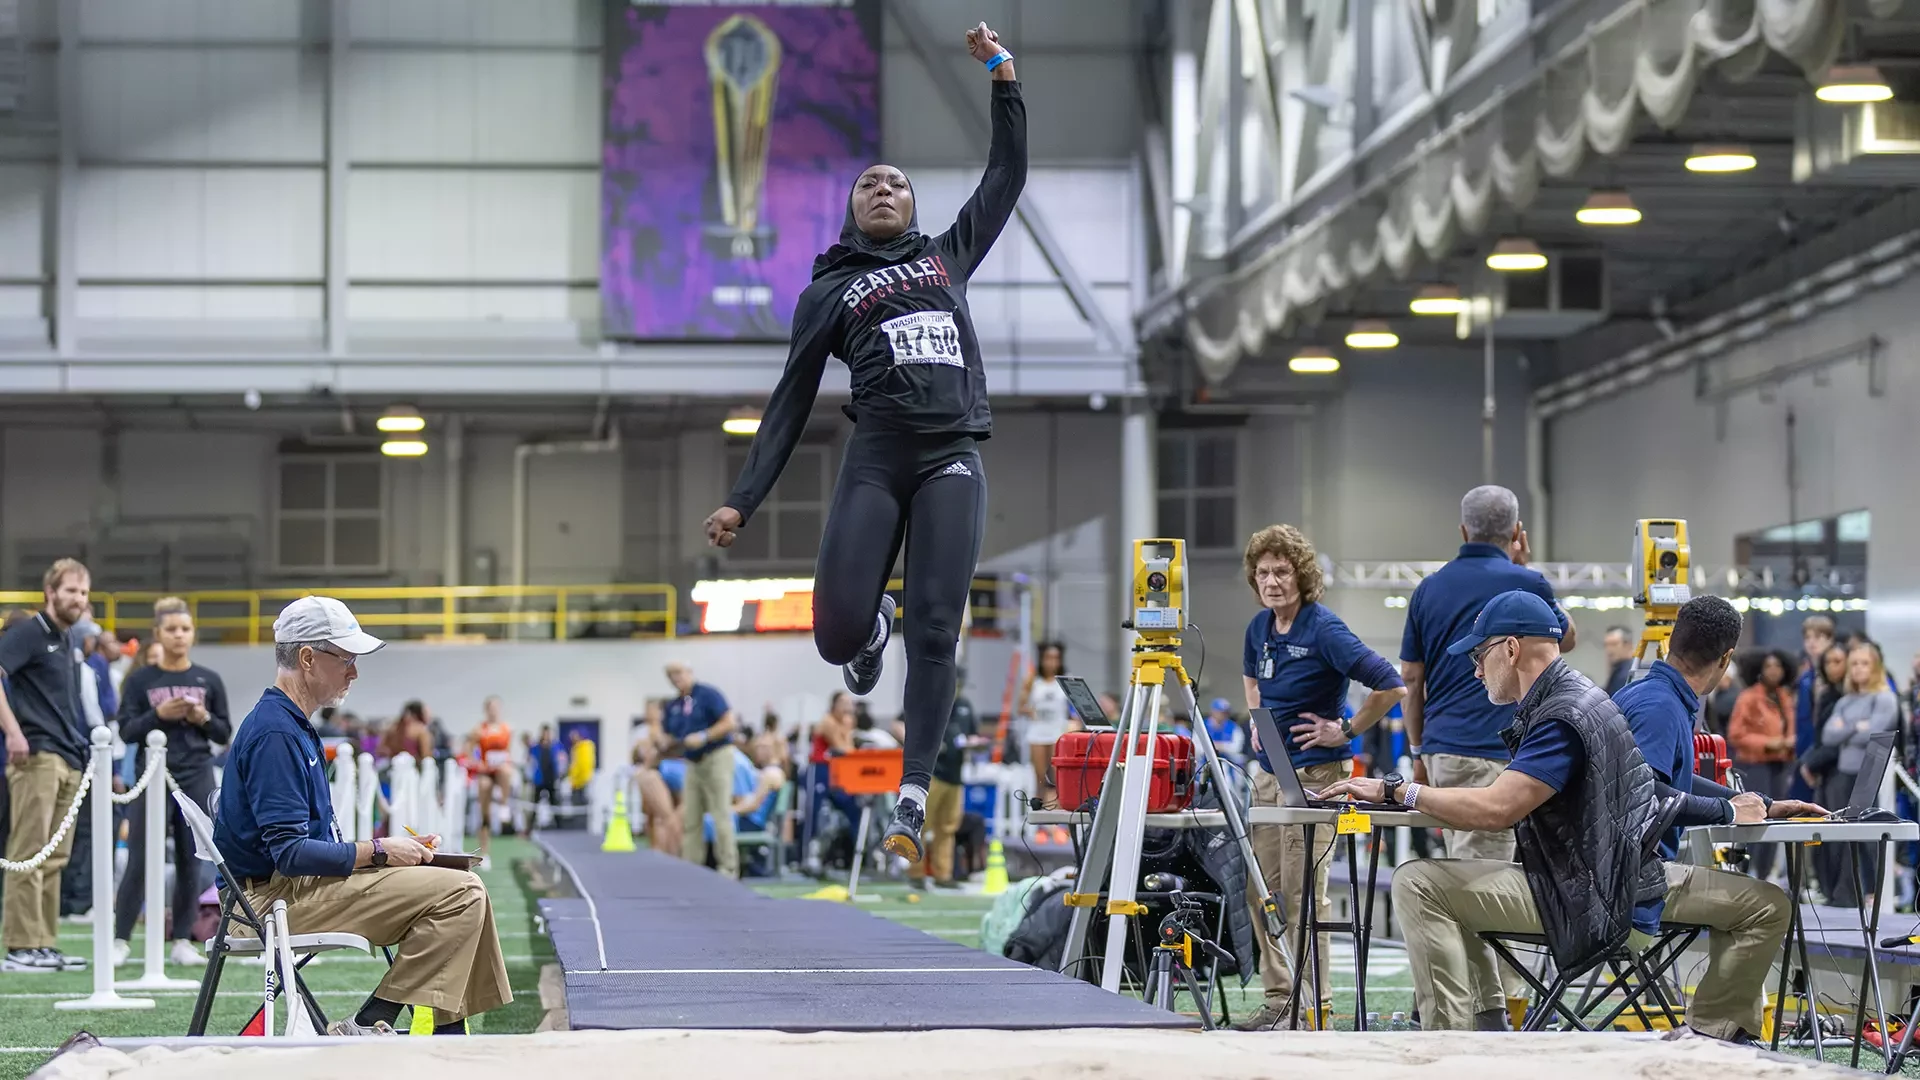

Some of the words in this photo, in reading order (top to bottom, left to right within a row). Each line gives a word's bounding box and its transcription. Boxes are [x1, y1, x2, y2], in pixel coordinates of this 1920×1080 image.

[853, 285, 895, 317] TRACK
[902, 280, 911, 292] &
[890, 314, 945, 329] WASHINGTON
